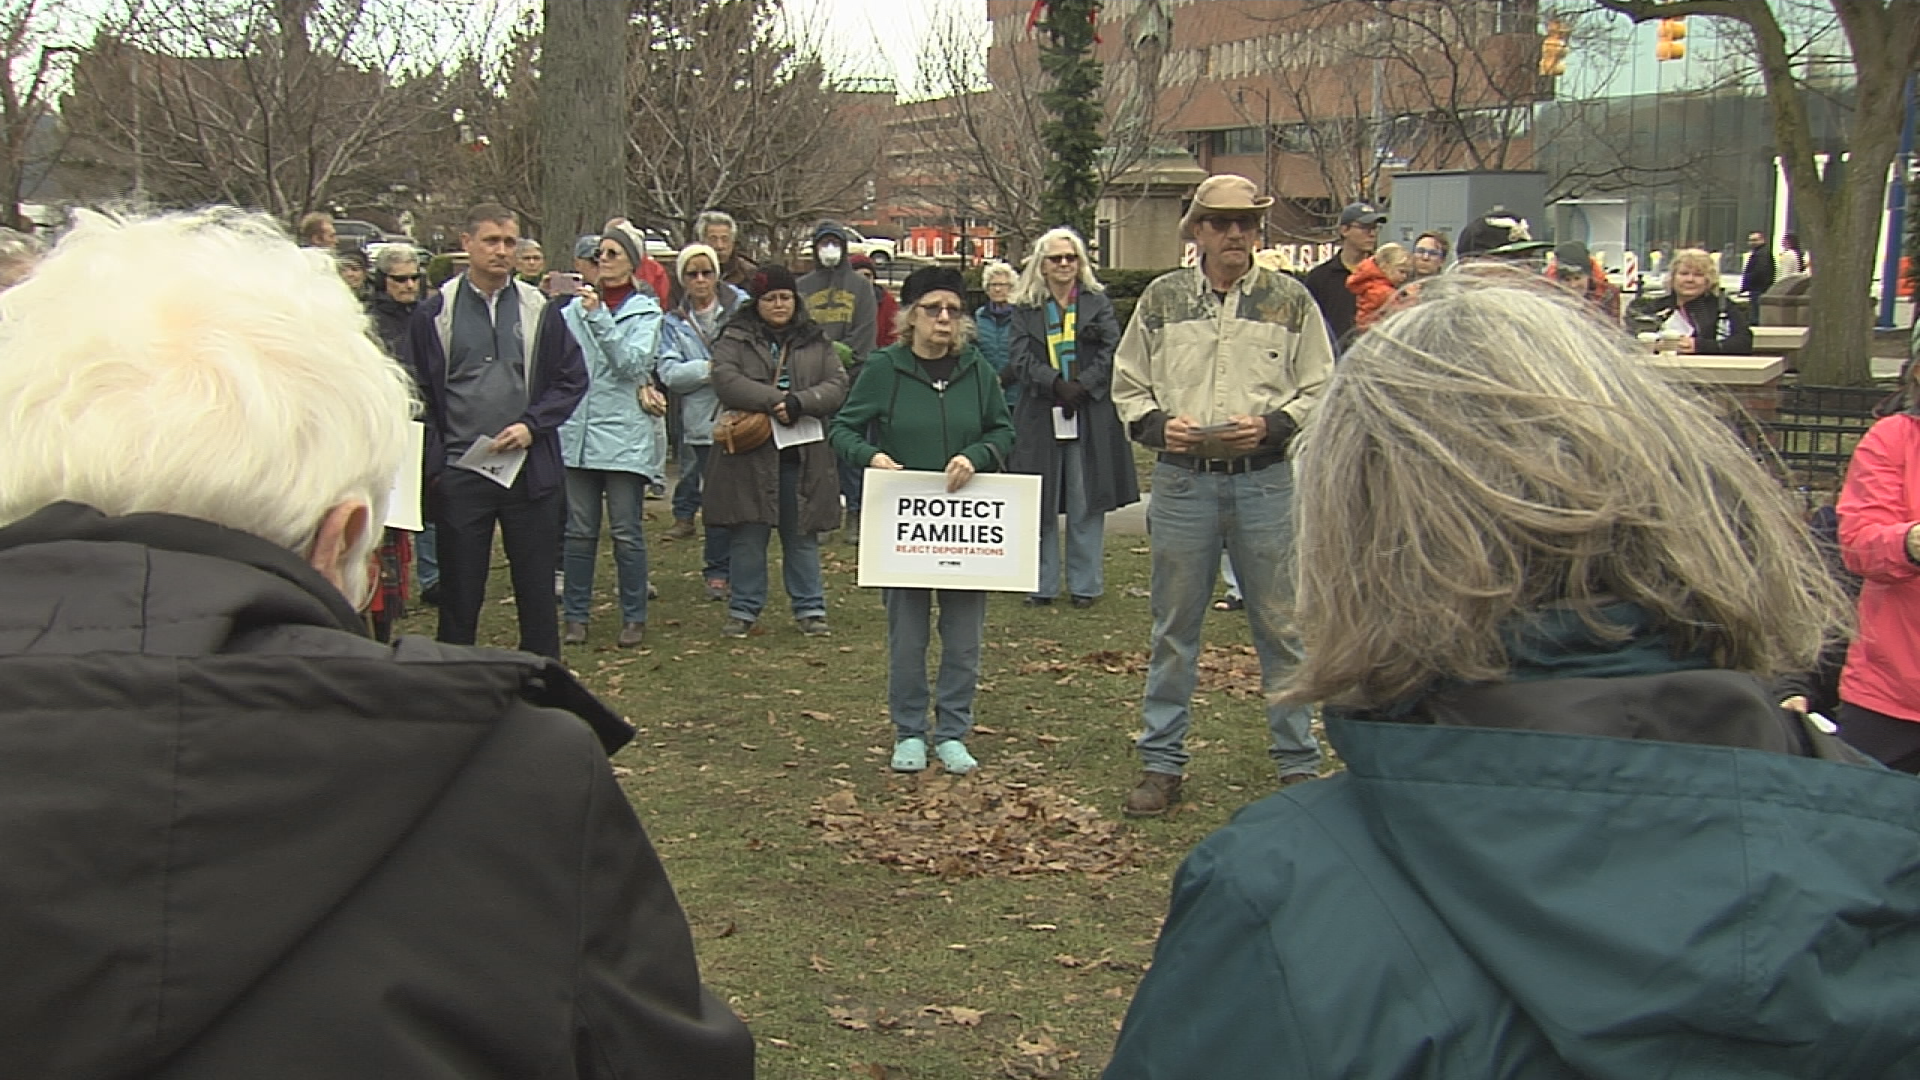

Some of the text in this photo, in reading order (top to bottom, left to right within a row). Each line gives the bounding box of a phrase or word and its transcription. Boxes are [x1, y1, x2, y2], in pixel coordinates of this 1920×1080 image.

[897, 498, 1005, 519] PROTECT
[897, 522, 1004, 544] FAMILIES
[896, 545, 1005, 556] REJECT DEPORTATIONS
